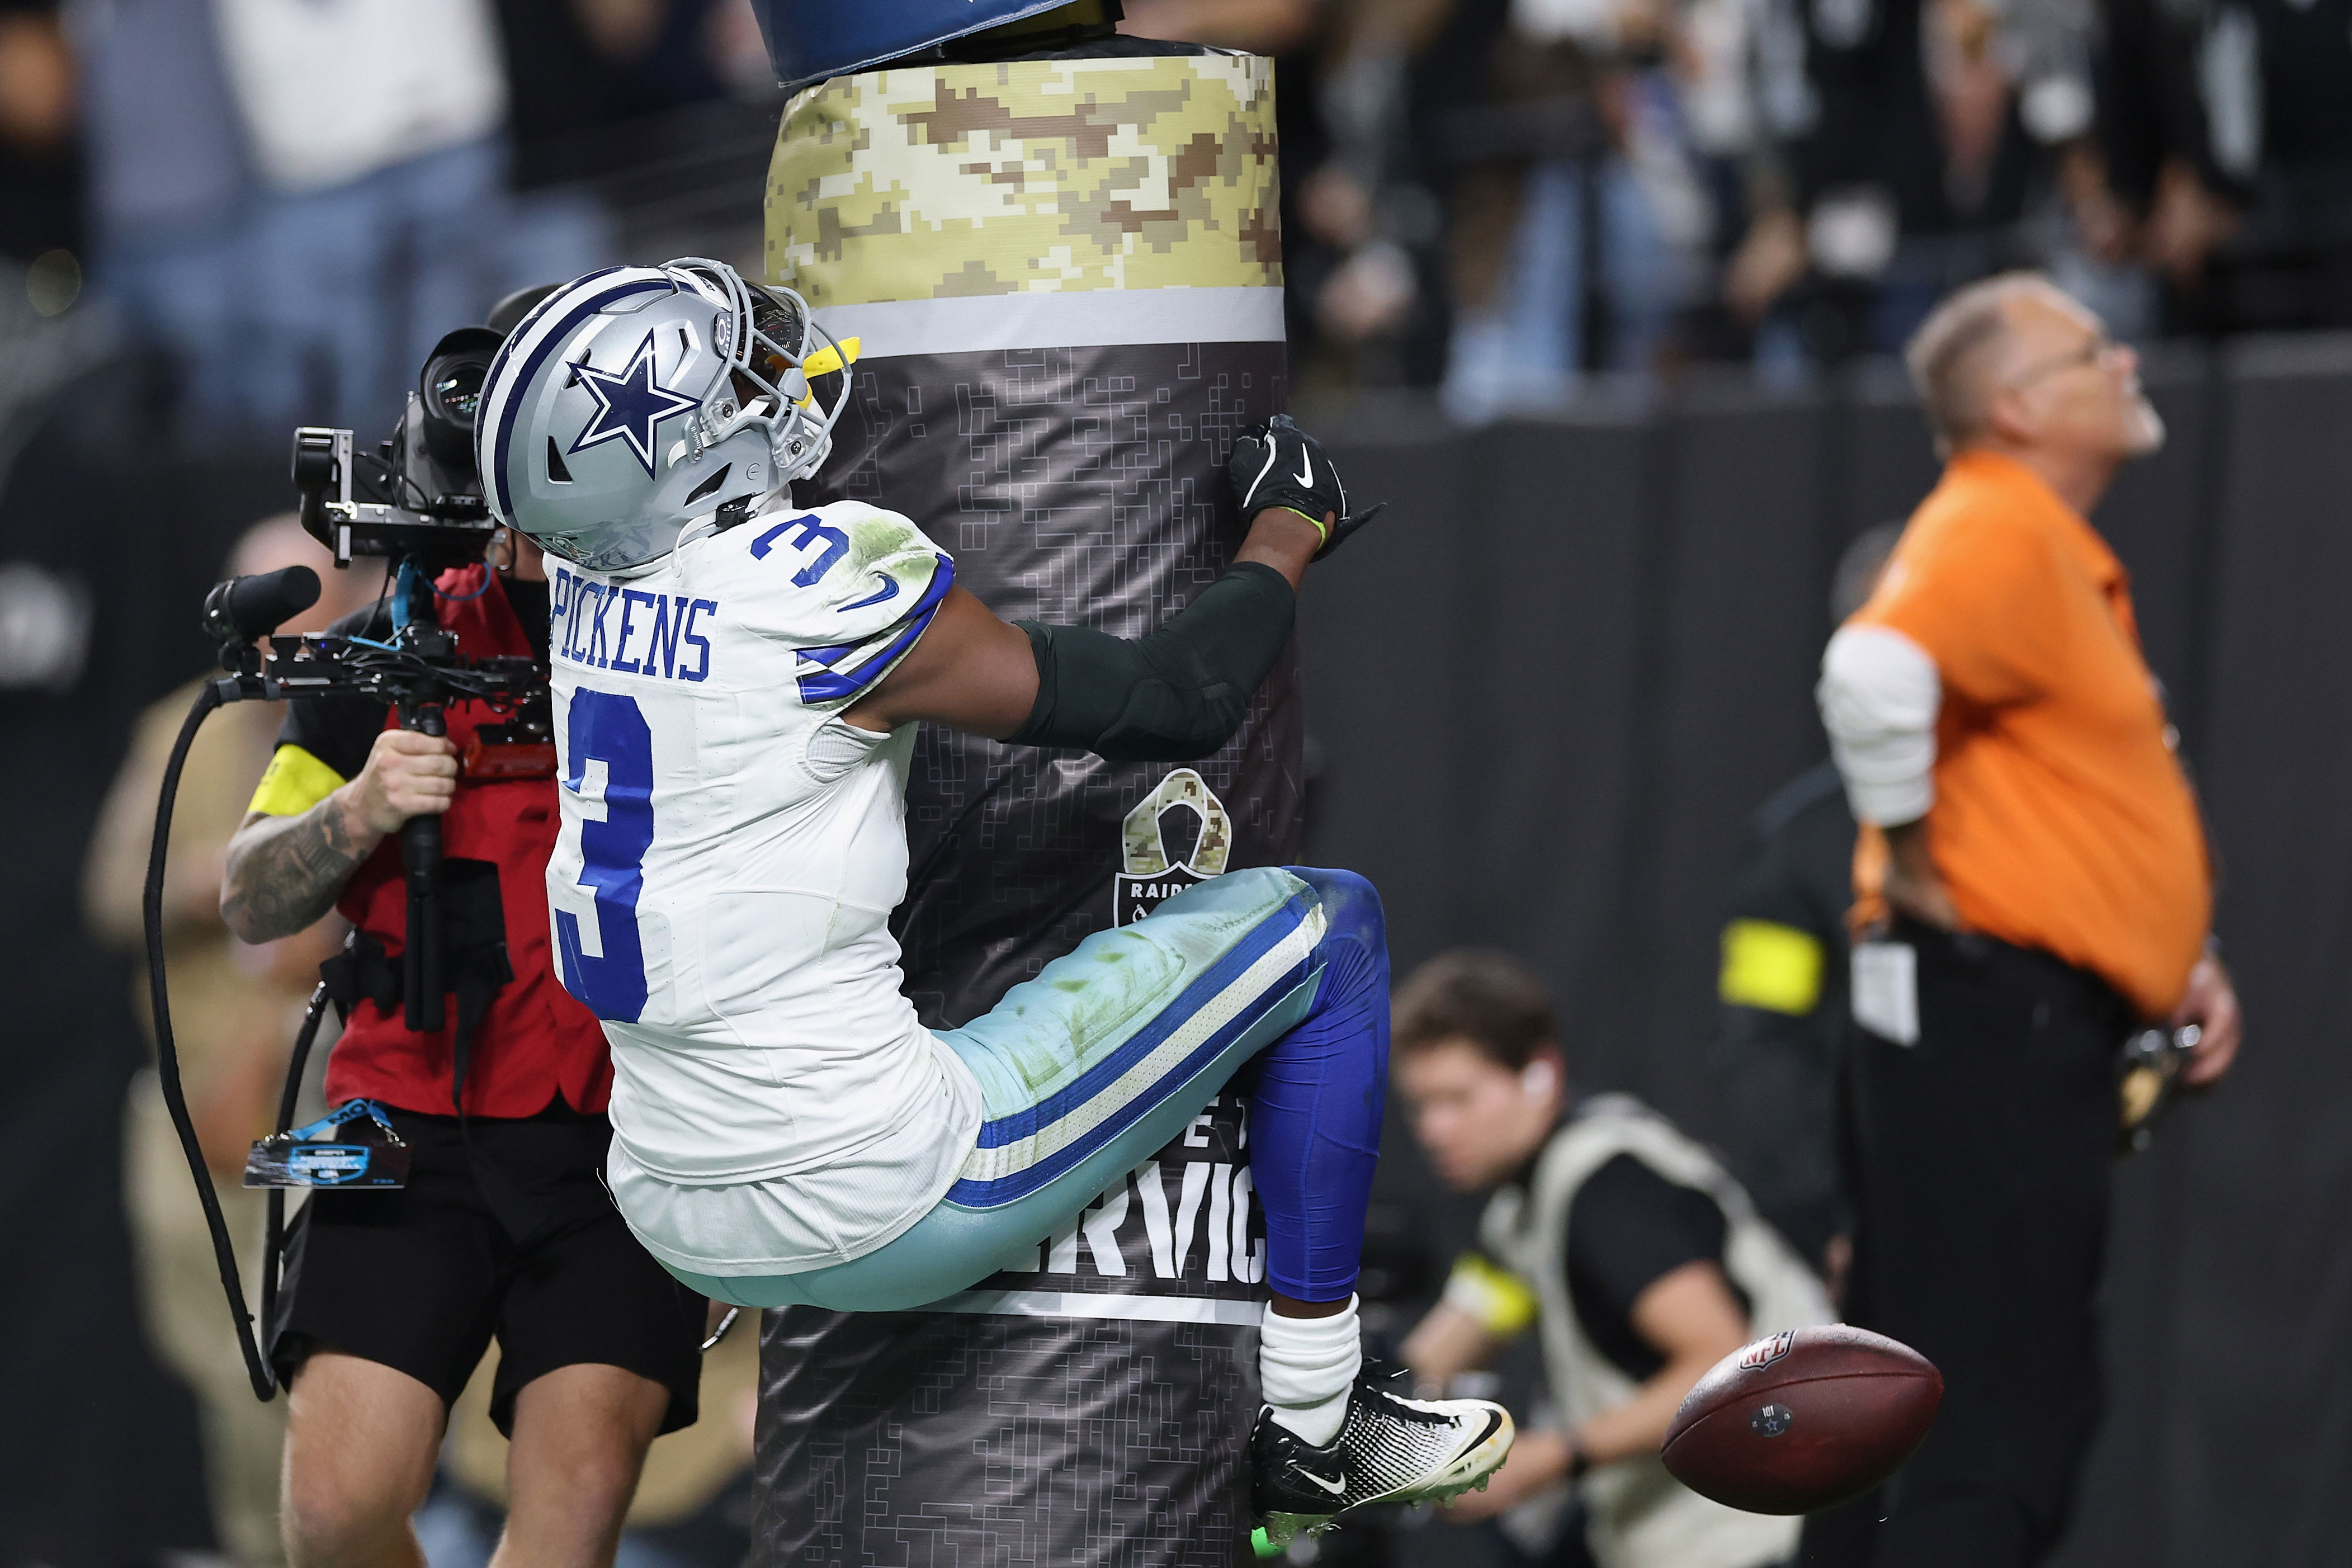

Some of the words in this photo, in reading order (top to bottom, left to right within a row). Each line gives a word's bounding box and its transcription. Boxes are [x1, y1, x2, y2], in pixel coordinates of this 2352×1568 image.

[724, 316, 732, 357] OAKLEY
[750, 513, 849, 588] 3
[550, 567, 718, 682] PICKENS
[554, 686, 654, 1023] 3
[1130, 883, 1193, 898] RAID
[1003, 1161, 1265, 1284] RVIC
[1745, 1340, 1786, 1365] NFL
